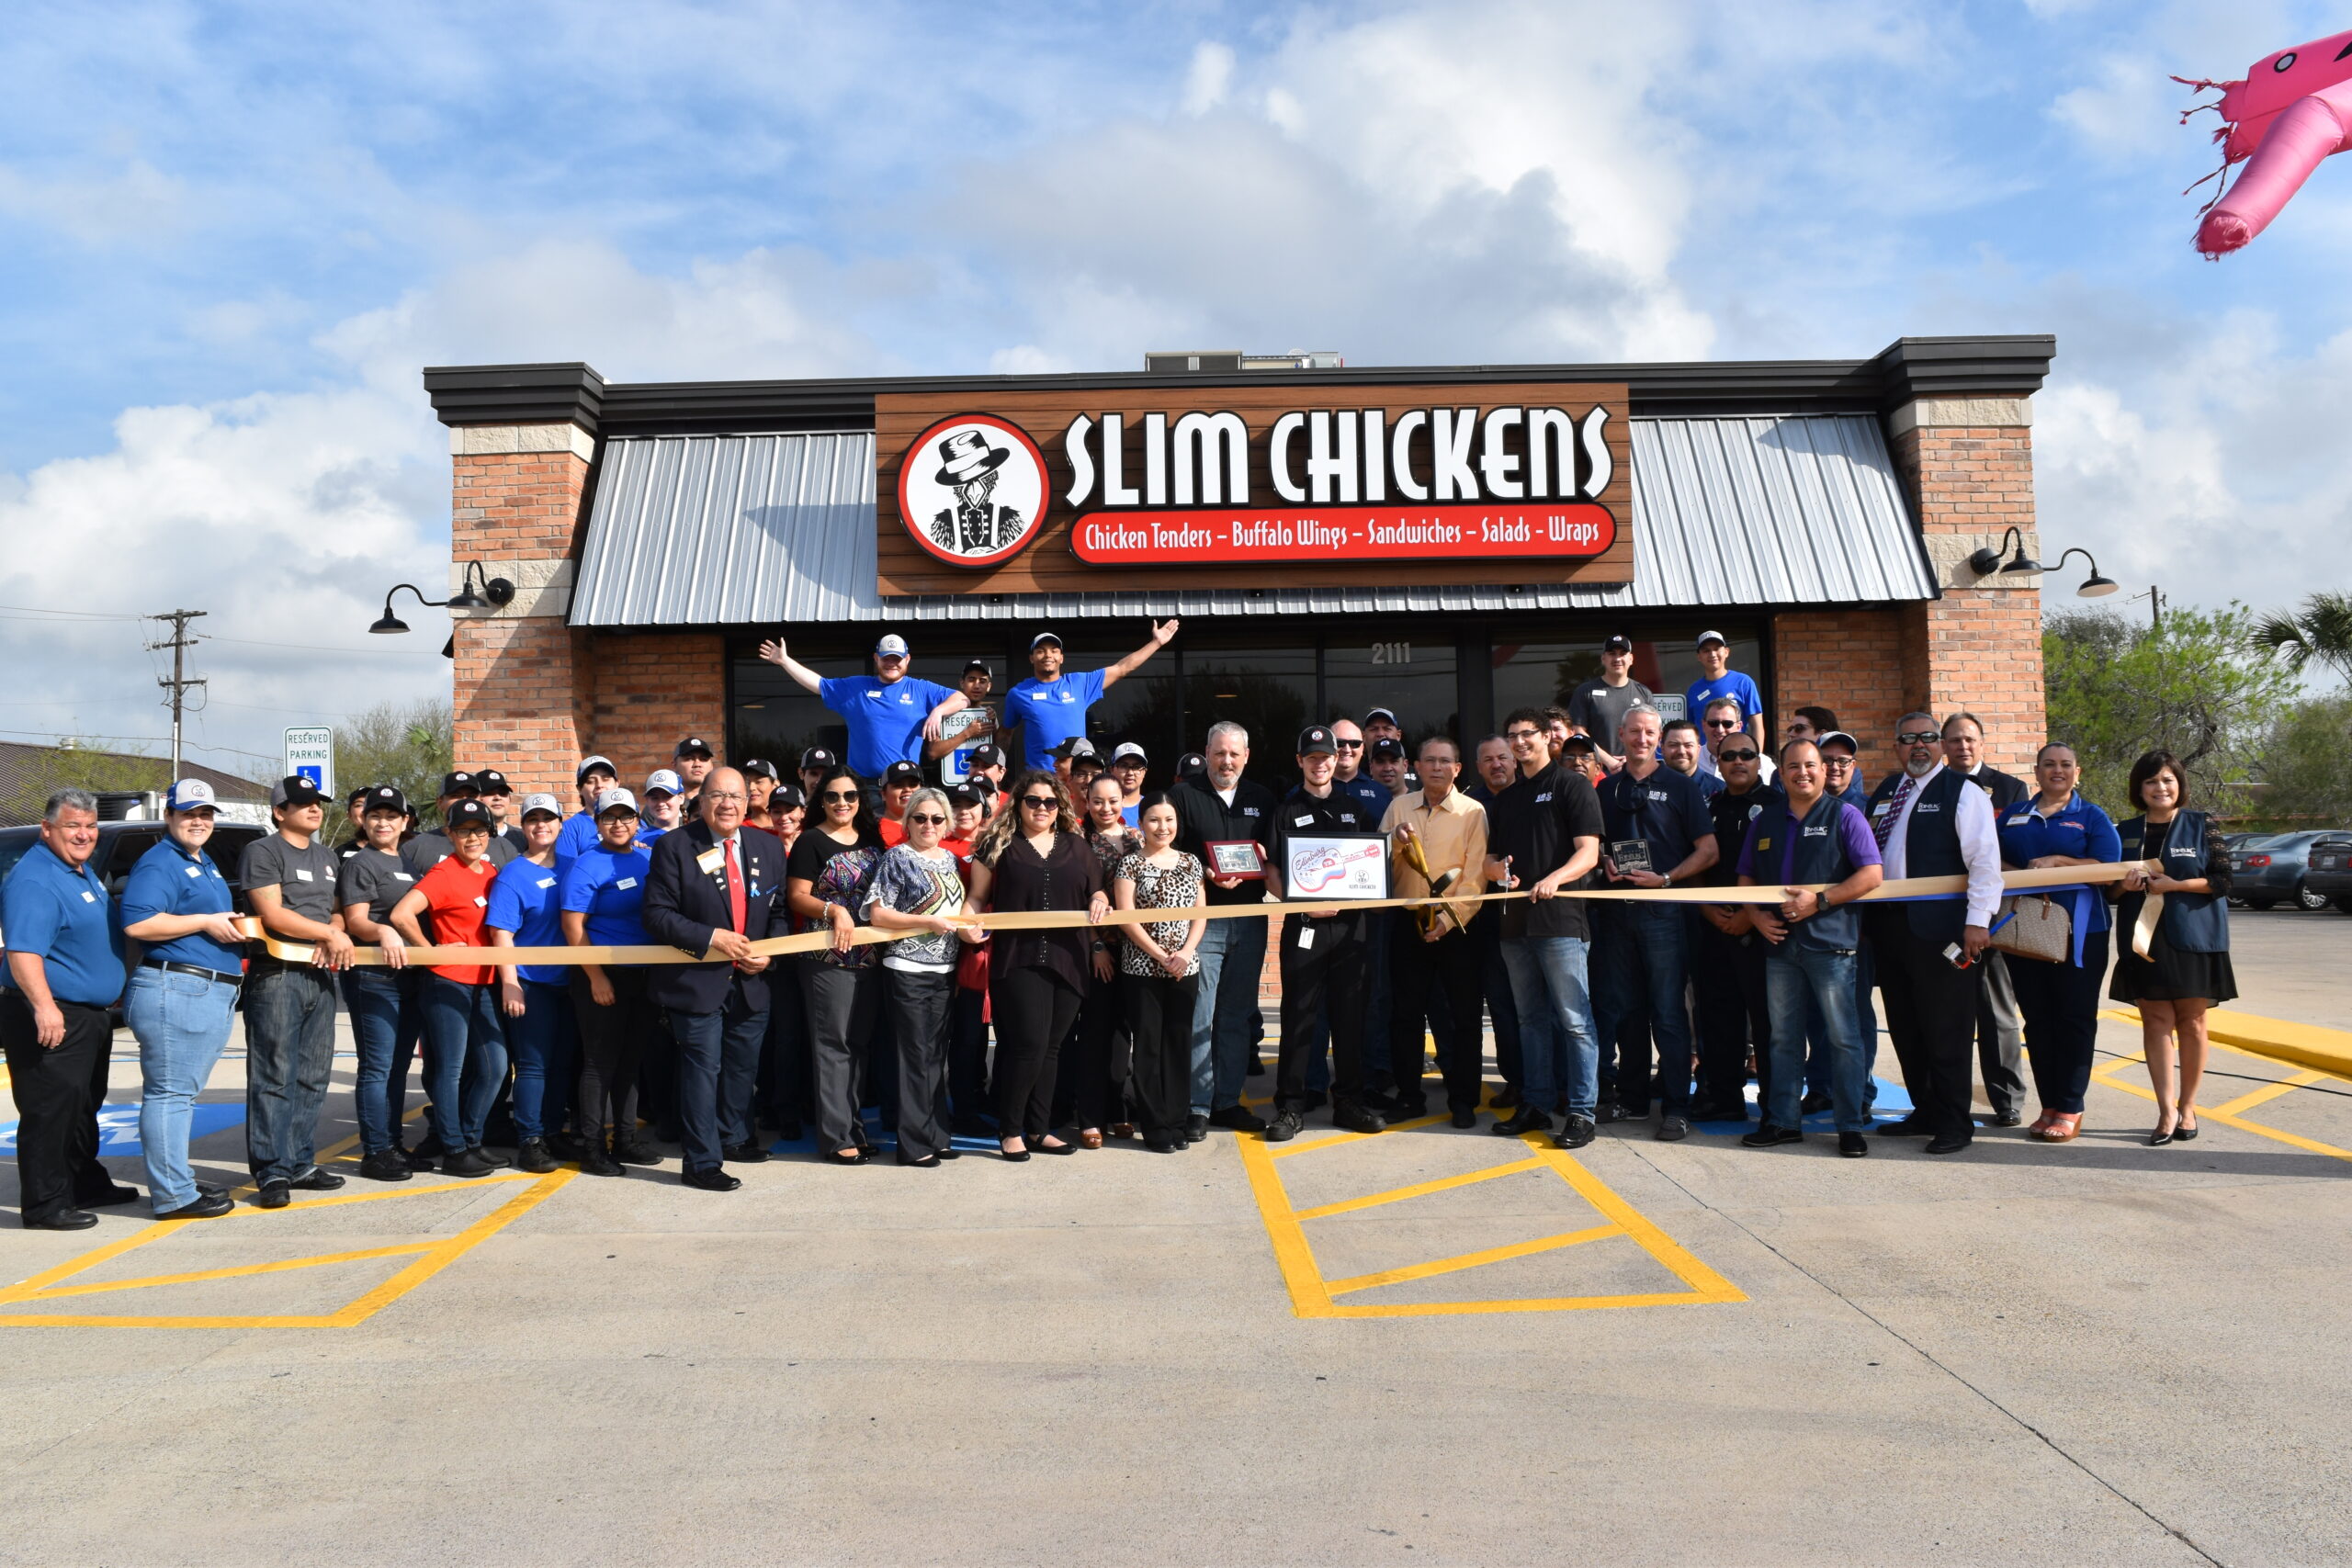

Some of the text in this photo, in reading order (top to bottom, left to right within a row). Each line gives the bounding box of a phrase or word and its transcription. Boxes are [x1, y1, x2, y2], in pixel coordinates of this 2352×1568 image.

[1065, 405, 1614, 508] SLIM CHICKENS
[1085, 524, 1148, 550] Chicken
[1150, 522, 1212, 548] Tenders
[1232, 520, 1293, 547] Buffalo
[1296, 519, 1348, 551] Wings
[1368, 517, 1461, 545] Sandwiches
[1481, 516, 1531, 543] Salads
[1548, 515, 1600, 547] Wraps
[1372, 642, 1410, 664] 2111
[1654, 702, 1682, 712] ERVED
[288, 734, 328, 743] RESERVED
[947, 733, 986, 742] PKING
[289, 750, 327, 760] PARKING
[1295, 847, 1326, 870] Edinburg
